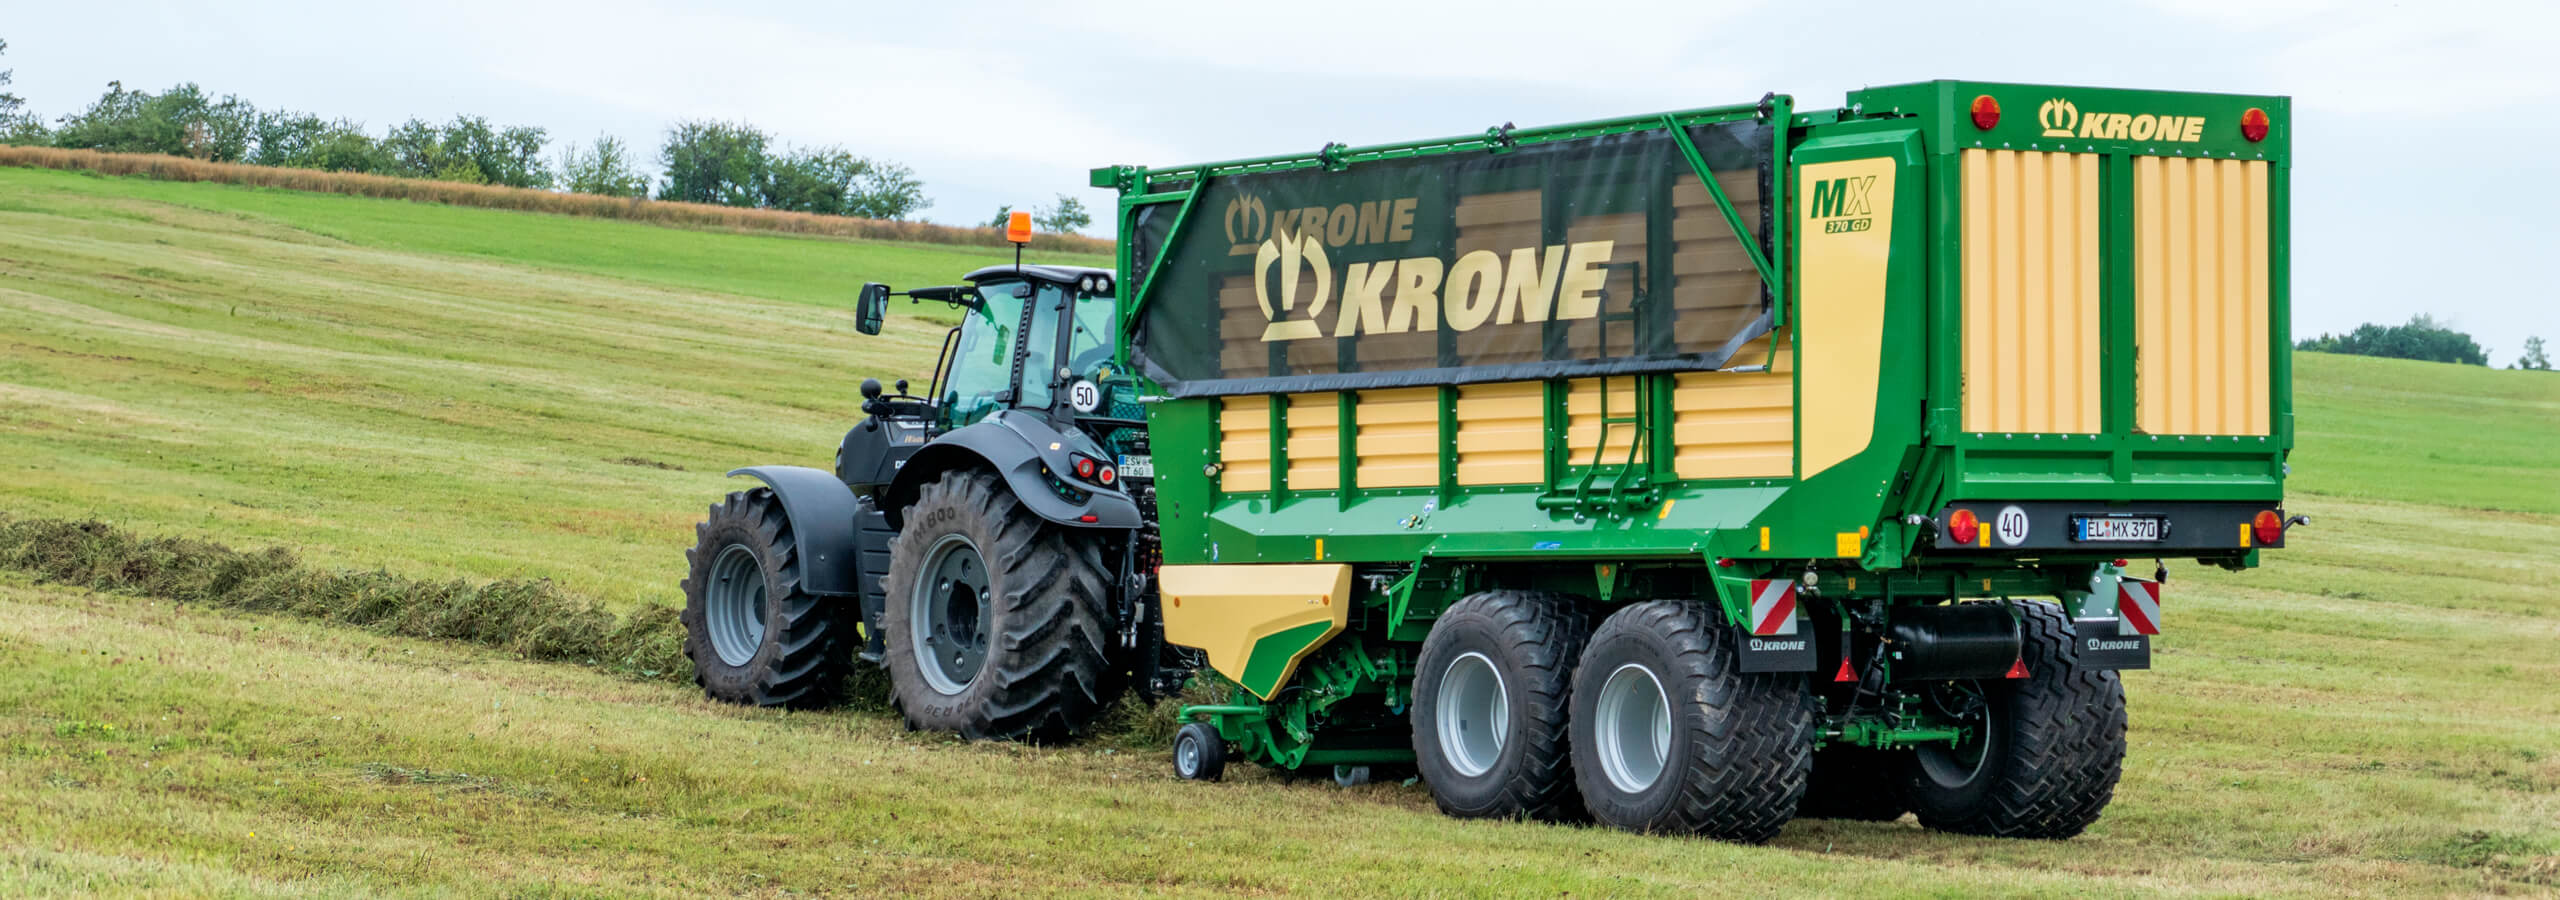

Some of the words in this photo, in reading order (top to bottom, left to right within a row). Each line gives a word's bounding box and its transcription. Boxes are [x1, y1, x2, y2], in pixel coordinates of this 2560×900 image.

[2079, 112, 2206, 143] KRONE
[1810, 175, 1877, 219] MX
[1270, 198, 1419, 248] KRONE
[1827, 221, 1849, 233] 370
[1851, 219, 1870, 231] GD
[1334, 239, 1615, 339] KRONE
[1076, 386, 1093, 406] 50
[2002, 513, 2023, 538] 40
[2087, 521, 2104, 537] EL
[2112, 521, 2129, 537] MX
[2131, 521, 2155, 537] 370
[1764, 640, 1806, 651] KRONE
[2100, 640, 2140, 650] KRONE
